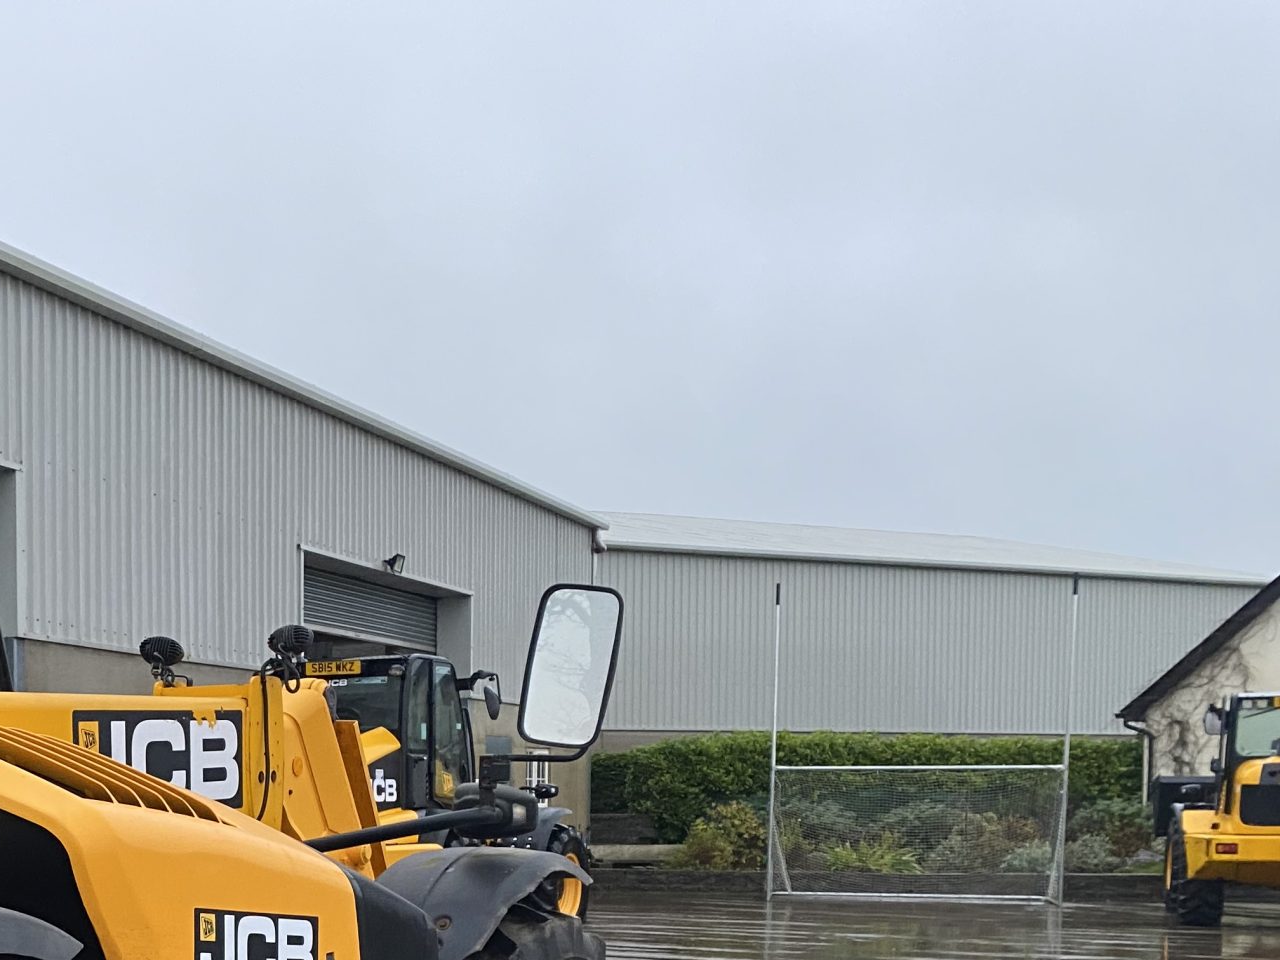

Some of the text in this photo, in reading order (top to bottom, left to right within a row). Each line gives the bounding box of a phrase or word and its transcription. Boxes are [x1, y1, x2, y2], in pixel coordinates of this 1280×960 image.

[312, 662, 355, 673] SB15 WKZ
[370, 778, 398, 803] CB
